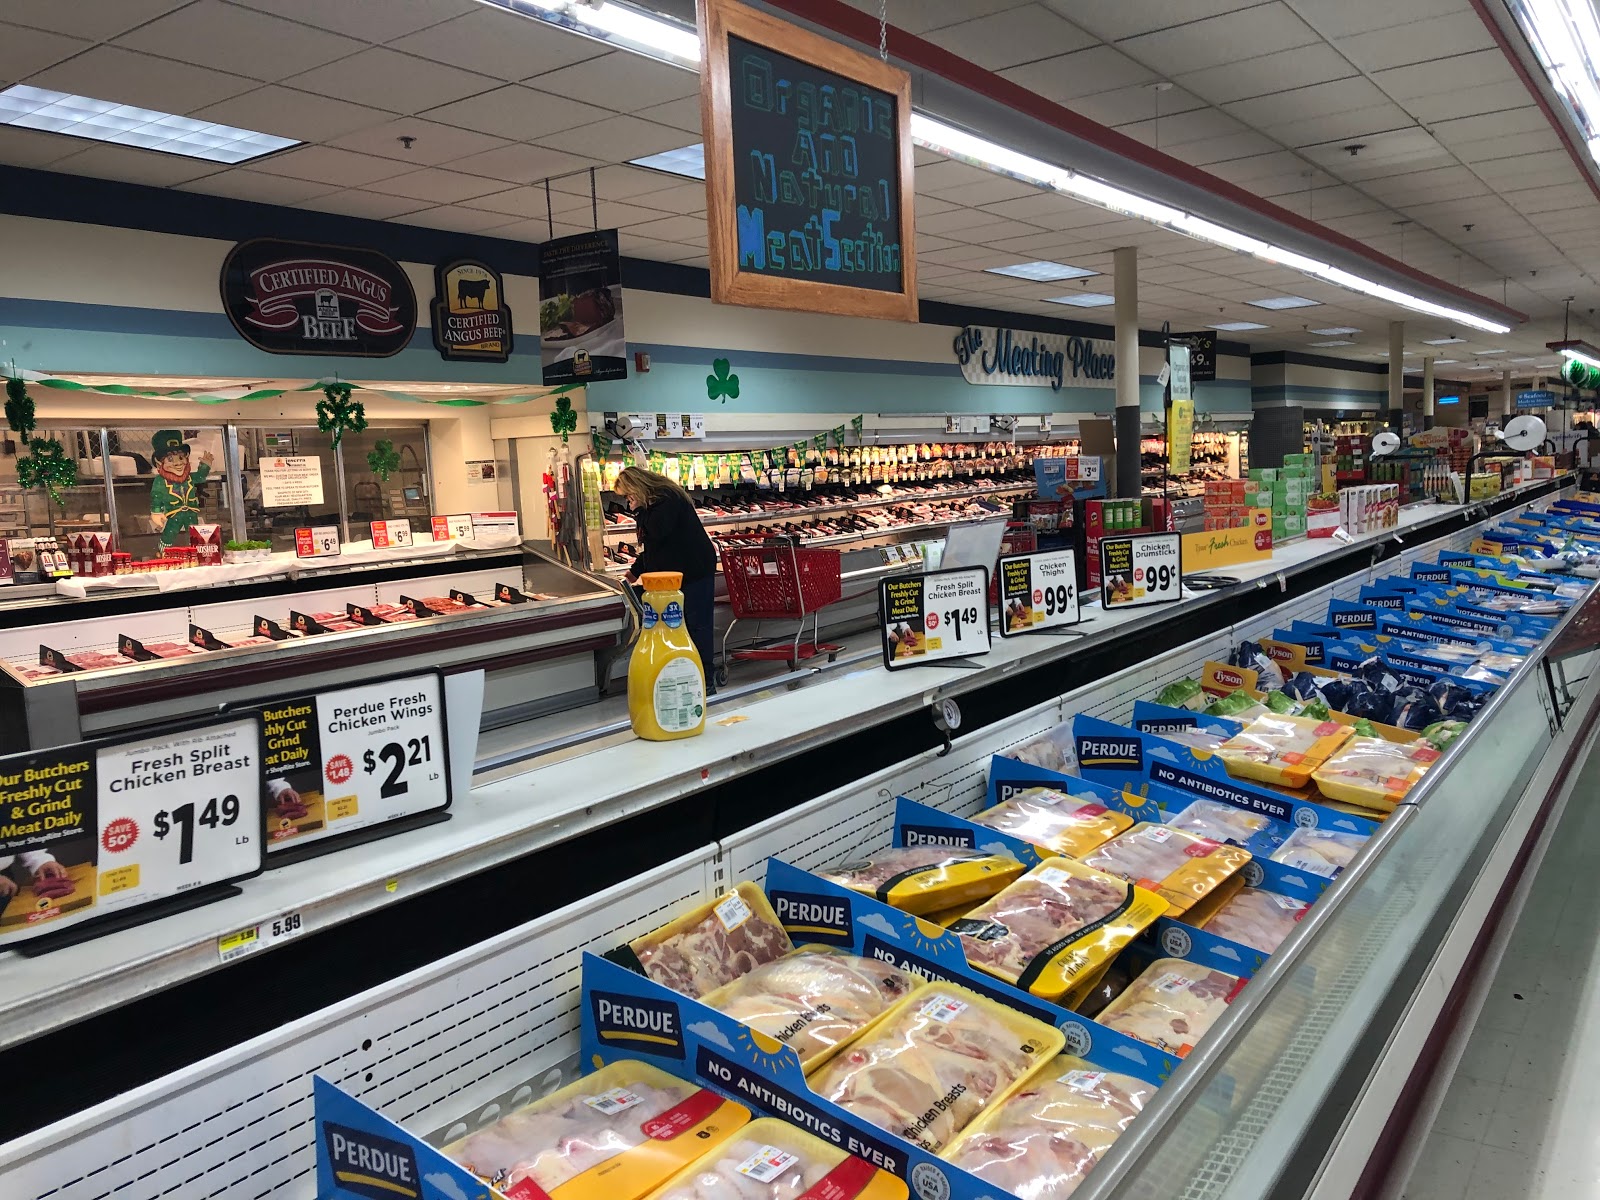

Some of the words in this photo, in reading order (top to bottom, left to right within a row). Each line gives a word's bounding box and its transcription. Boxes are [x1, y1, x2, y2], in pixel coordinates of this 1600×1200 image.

[737, 204, 823, 271] Meat
[259, 268, 339, 293] CERTIFIED
[340, 270, 387, 302] ANGUS
[302, 315, 356, 340] BEEF
[448, 313, 500, 329] CERTIFIED
[445, 329, 482, 343] ANGUS
[982, 328, 1064, 391] Meating
[1067, 336, 1115, 380] Place
[1141, 543, 1171, 551] Chicken
[1209, 534, 1229, 554] Fresh
[1135, 548, 1176, 558] Drumsticks
[1039, 562, 1067, 571] Chicken
[1042, 569, 1065, 577] Thighs
[1416, 573, 1448, 581] PERDUE
[899, 581, 921, 589] Butchers
[957, 581, 973, 589] Split
[891, 590, 909, 598] Freshly
[900, 596, 915, 606] Grind
[928, 591, 956, 600] Chicken
[958, 588, 981, 597] Breast
[669, 604, 678, 612] 3X
[892, 607, 905, 615] Meat
[905, 605, 918, 614] Daily
[1366, 599, 1402, 609] PERDUE
[1335, 612, 1374, 623] PERDUE
[1474, 623, 1494, 631] EVER
[1267, 645, 1293, 659] Tyson
[1337, 661, 1350, 669] NO
[1215, 670, 1244, 686] Tyson
[334, 702, 385, 719] Perdue
[390, 692, 427, 709] Fresh
[263, 706, 312, 722] Butchers
[328, 715, 387, 733] Chicken
[391, 703, 433, 722] Wings
[264, 723, 285, 736] shly
[286, 720, 307, 731] Cut
[387, 725, 400, 733] Pack
[268, 733, 300, 749] Grind
[1082, 740, 1137, 757] PERDUE
[131, 753, 183, 774] Fresh
[190, 744, 231, 763] Split
[281, 747, 309, 761] Daily
[24, 761, 89, 783] Butchers
[329, 759, 348, 770] SAVE
[110, 768, 187, 793] Chicken
[193, 755, 250, 777] Breast
[429, 772, 439, 781] Lb
[54, 779, 82, 793] Cut
[1158, 768, 1176, 781] NO
[1179, 776, 1249, 805] ANTIBIOTICS
[1253, 799, 1285, 816] EVER
[11, 806, 25, 820] &
[28, 795, 71, 816] Grind
[0, 821, 41, 839] Meat
[44, 811, 82, 830] Daily
[107, 823, 132, 836] SAVE
[235, 835, 250, 845] Lb
[777, 897, 845, 925] PERDUE
[272, 913, 301, 937] 5.99
[874, 947, 896, 965] NO
[598, 999, 673, 1033] PERDUE
[774, 1019, 806, 1043] hicken
[1067, 1034, 1082, 1046] USA
[708, 1060, 732, 1081] NO
[738, 1077, 841, 1142] ANTIBIOTICS
[848, 1136, 896, 1173] EVER
[903, 1100, 942, 1140] Chicken
[939, 1082, 967, 1112] Breasts
[332, 1132, 411, 1182] PERDUE
[922, 1178, 939, 1193] USA
